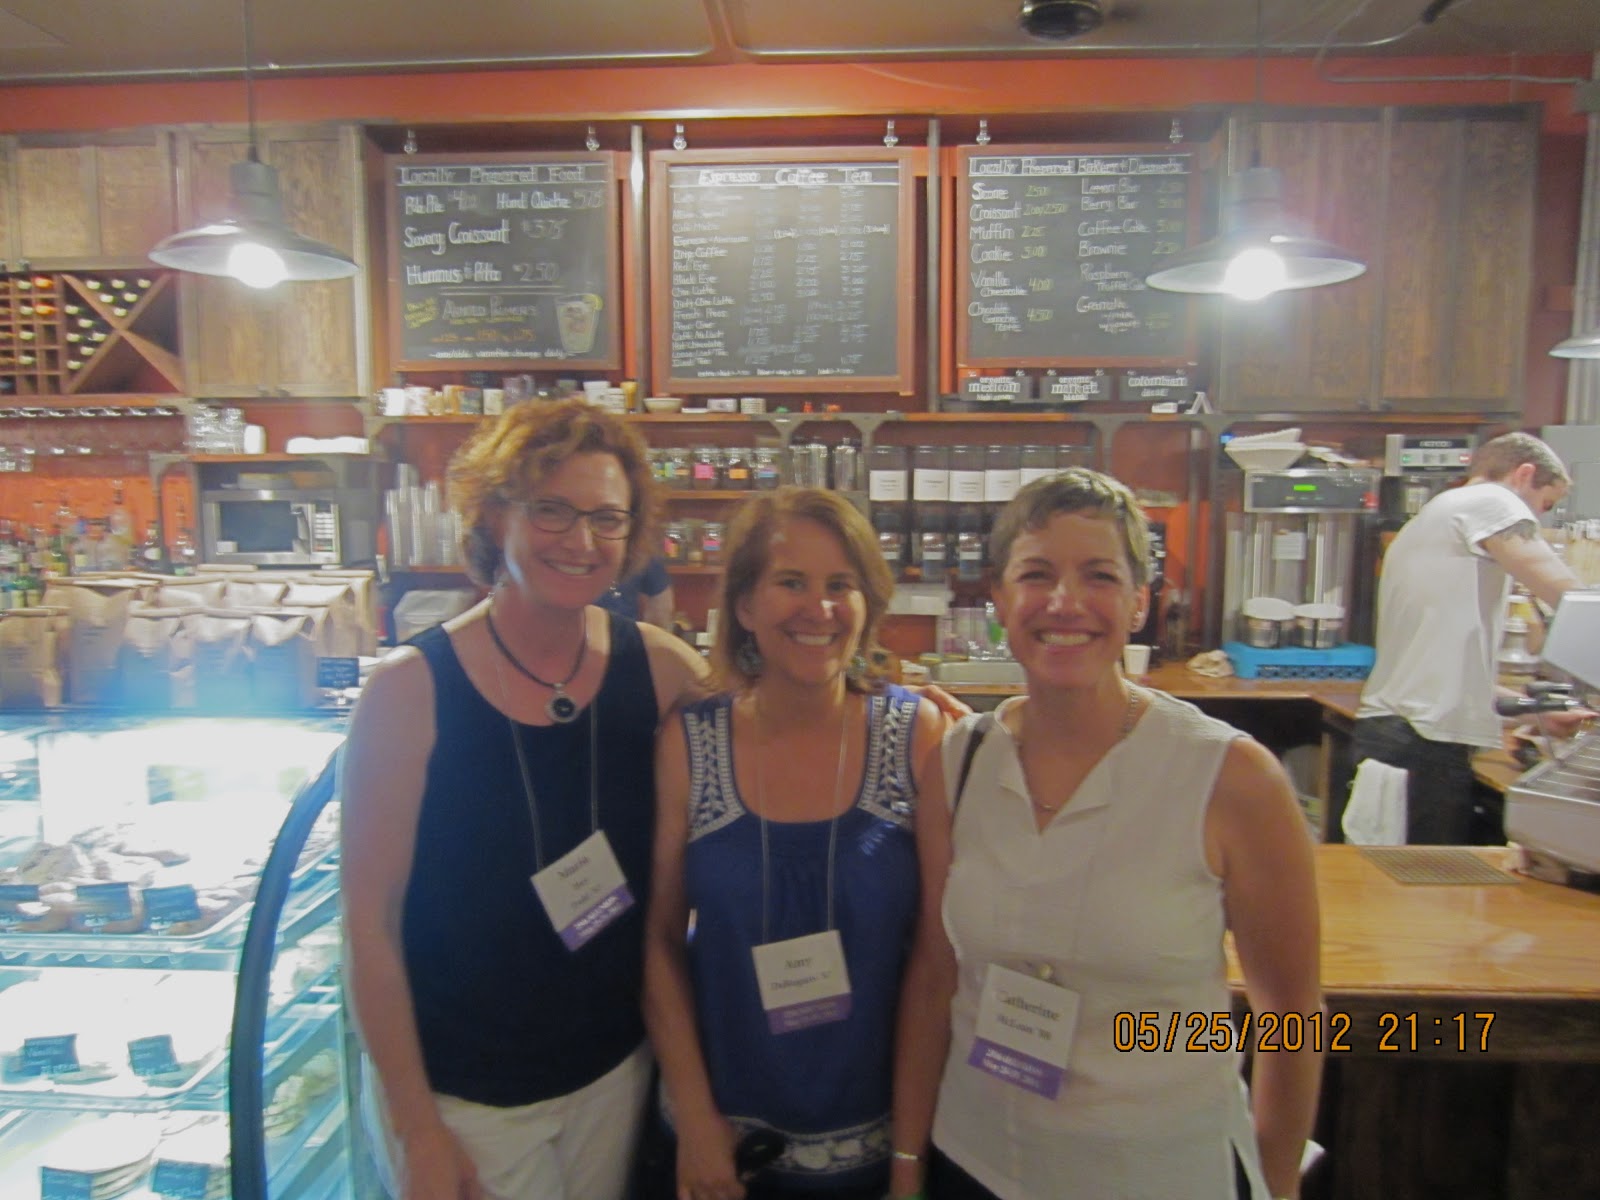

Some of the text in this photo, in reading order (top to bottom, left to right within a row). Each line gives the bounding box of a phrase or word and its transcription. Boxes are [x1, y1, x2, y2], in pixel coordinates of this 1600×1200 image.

[698, 168, 873, 186] Espresso Coffee Tea
[1081, 177, 1118, 194] Lemon
[972, 182, 1009, 200] Scone
[970, 201, 1022, 221] Croissant
[1081, 196, 1114, 212] Berry
[1117, 195, 1139, 210] Bar
[970, 223, 1015, 240] Muffin
[1078, 220, 1123, 236] Coffee
[403, 227, 446, 256] Savory
[449, 219, 511, 244] Croissant
[971, 244, 1013, 263] Cookie
[1079, 240, 1128, 256] Brownie
[406, 265, 463, 286] Hummus
[971, 270, 1010, 288] Vanilla
[968, 382, 1020, 393] mexican
[1051, 382, 1100, 394] market
[1128, 376, 1188, 387] colombian
